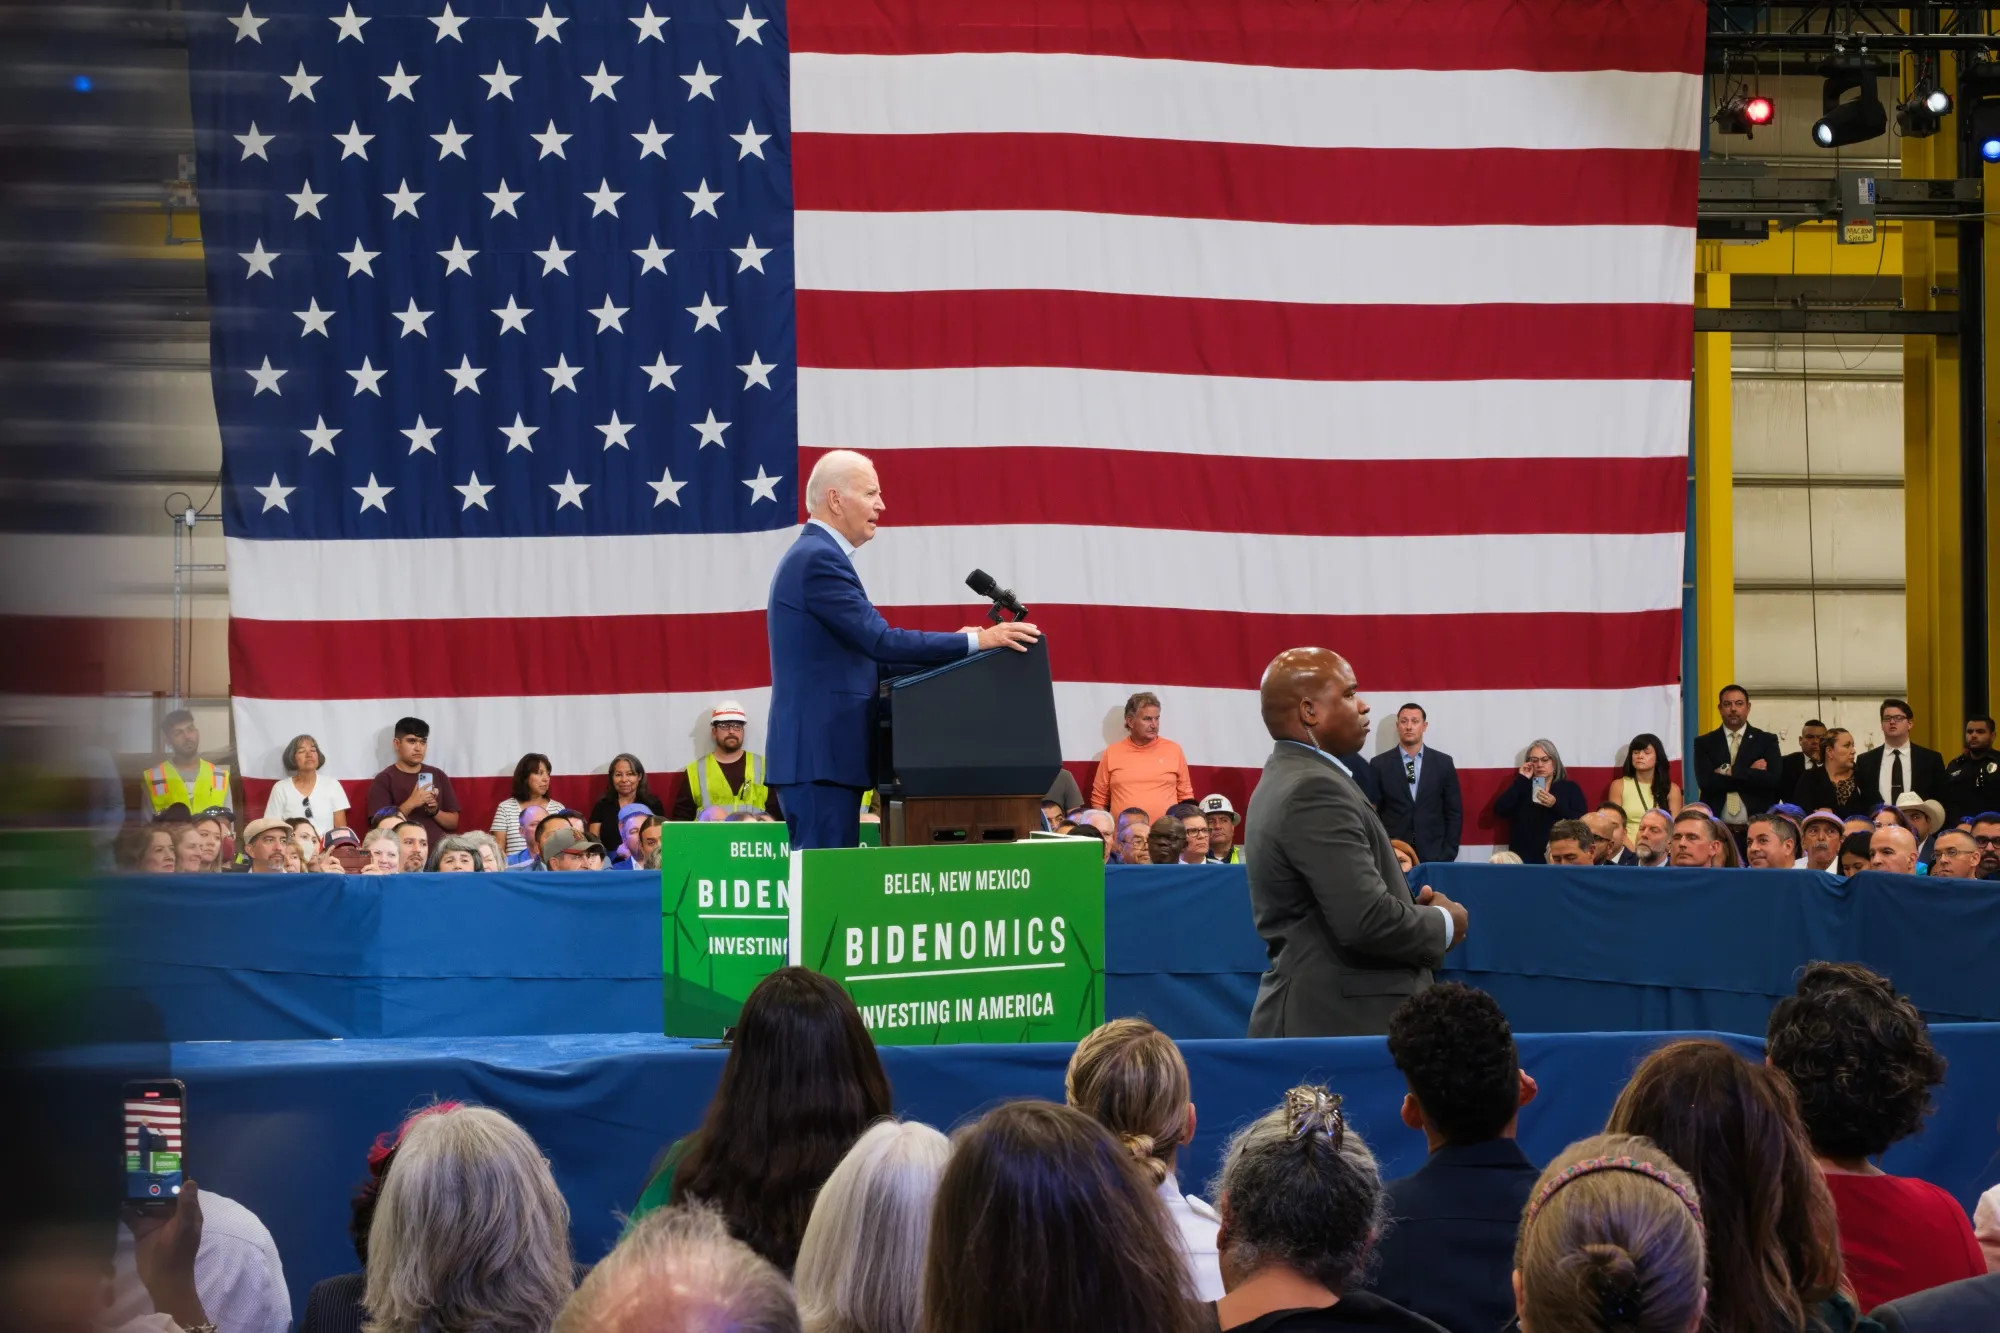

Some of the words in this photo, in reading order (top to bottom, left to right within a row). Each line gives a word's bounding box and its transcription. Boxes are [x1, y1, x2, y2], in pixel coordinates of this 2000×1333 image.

[730, 841, 776, 860] BELEN,
[885, 873, 935, 896] BELEN,
[939, 870, 971, 891] NEW
[975, 868, 1030, 890] MEXICO
[846, 916, 1065, 966] BIDENOMICS
[955, 998, 972, 1022] IN
[977, 992, 1054, 1020] AMERICA
